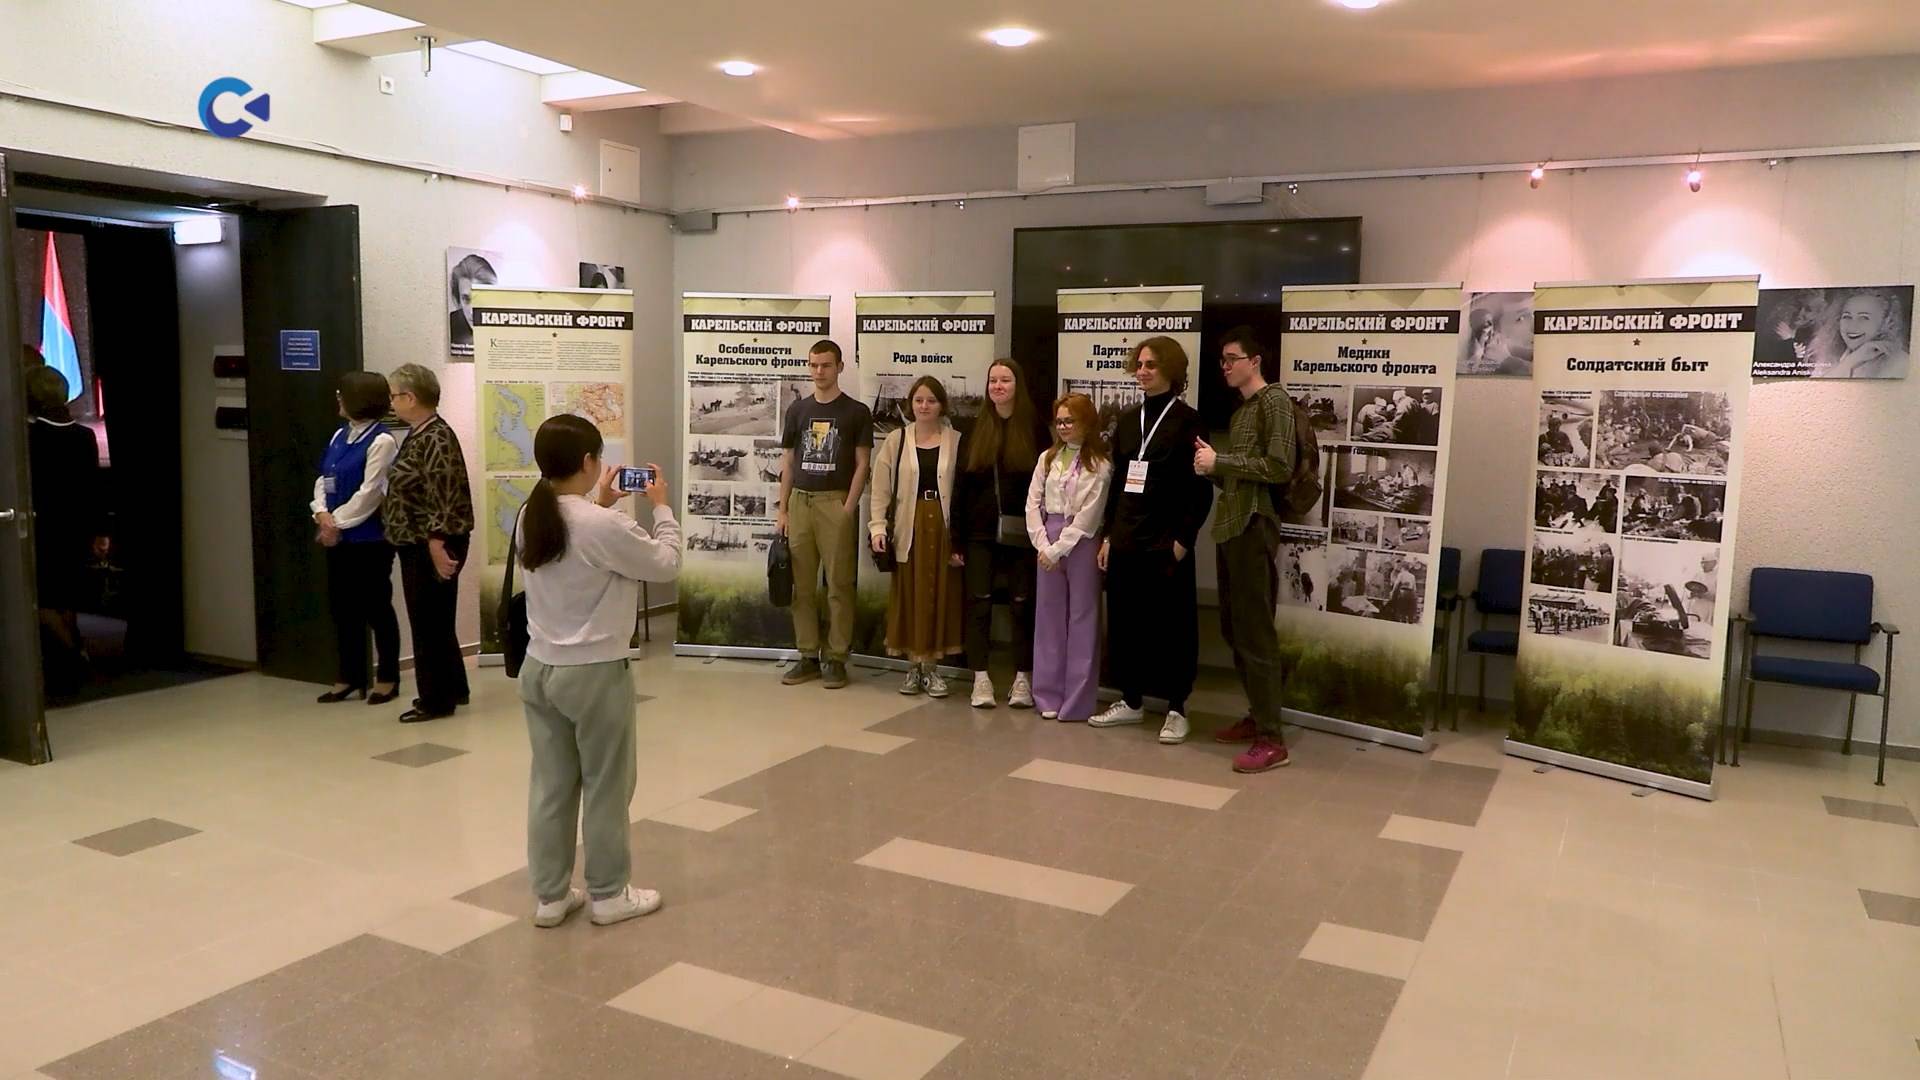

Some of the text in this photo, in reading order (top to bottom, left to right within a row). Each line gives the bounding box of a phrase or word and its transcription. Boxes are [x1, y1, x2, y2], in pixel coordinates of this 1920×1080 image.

[481, 312, 625, 328] КАРЕЛЬСКИЙ ФРОНТ
[691, 318, 822, 333] КАРЕЛЬСКИЙ ФРОНТ
[863, 317, 986, 332] КАРЕЛЬСКИЙ ФРОНТ
[1064, 314, 1192, 330] КАРЕЛЬСКИЙ ФРОНТ
[1290, 314, 1449, 331] КАРЕЛЬСКИЙ ФРОНТ
[1543, 311, 1743, 331] КАРЕЛЬСКИЙ ФРОНТ
[718, 344, 792, 355] Особенности
[1093, 344, 1130, 358] Парти
[1338, 346, 1391, 361] Медики
[696, 354, 809, 368] Карельского фронт
[893, 352, 953, 364] Рода войск
[1086, 360, 1129, 371] и разве
[1567, 356, 1709, 373] Солдатский быт
[1293, 360, 1437, 377] Карельского фронта
